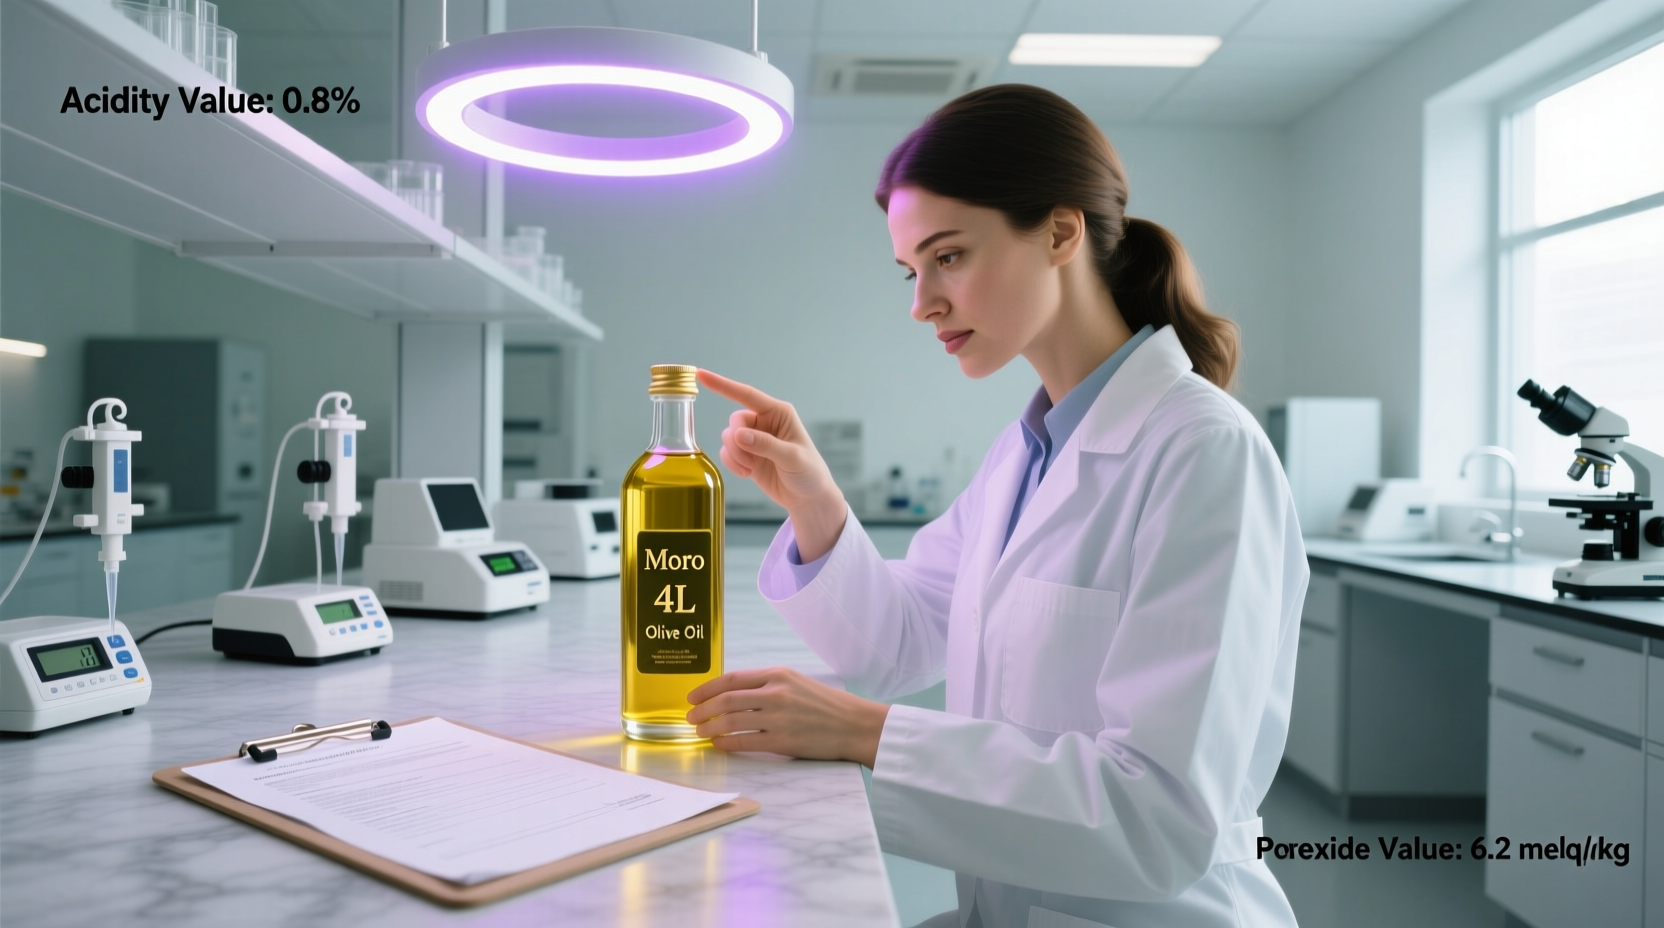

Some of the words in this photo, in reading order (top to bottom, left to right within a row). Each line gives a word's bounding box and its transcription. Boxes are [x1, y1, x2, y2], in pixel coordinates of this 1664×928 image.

[644, 548, 705, 571] Moro
[653, 584, 696, 614] 4L
[645, 624, 680, 640] Olive
[684, 624, 704, 640] Oil
